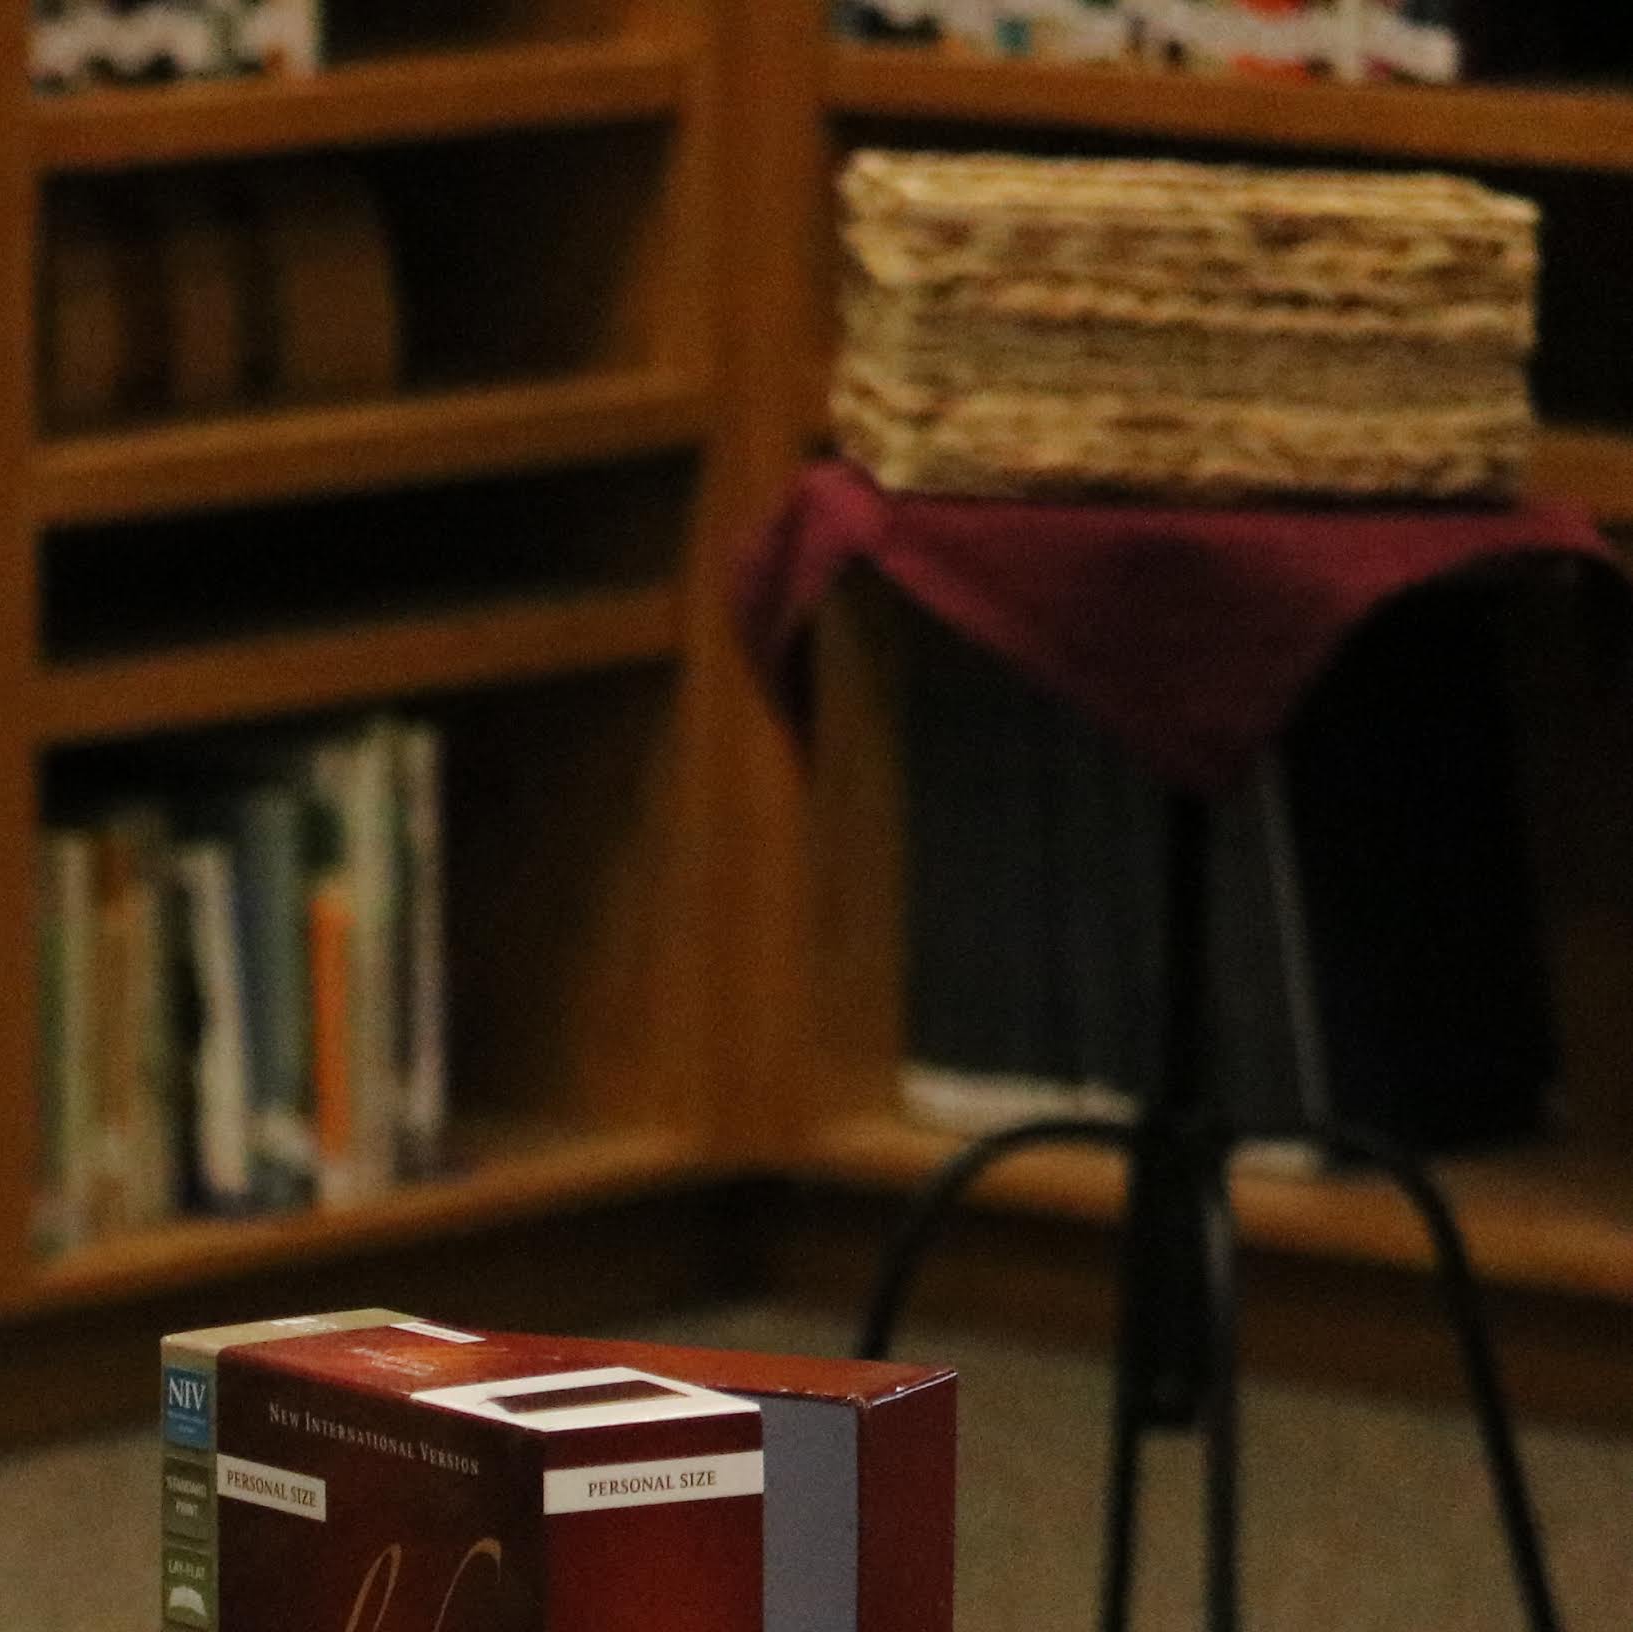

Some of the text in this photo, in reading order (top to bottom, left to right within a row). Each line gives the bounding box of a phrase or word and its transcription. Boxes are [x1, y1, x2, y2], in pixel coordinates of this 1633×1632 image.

[168, 1375, 208, 1412] NIV
[268, 1401, 480, 1475] NEW INTERNATIONAL VERSION
[226, 1470, 317, 1508] PERSONAL SIZE
[588, 1470, 717, 1498] PERSONAL SIZE
